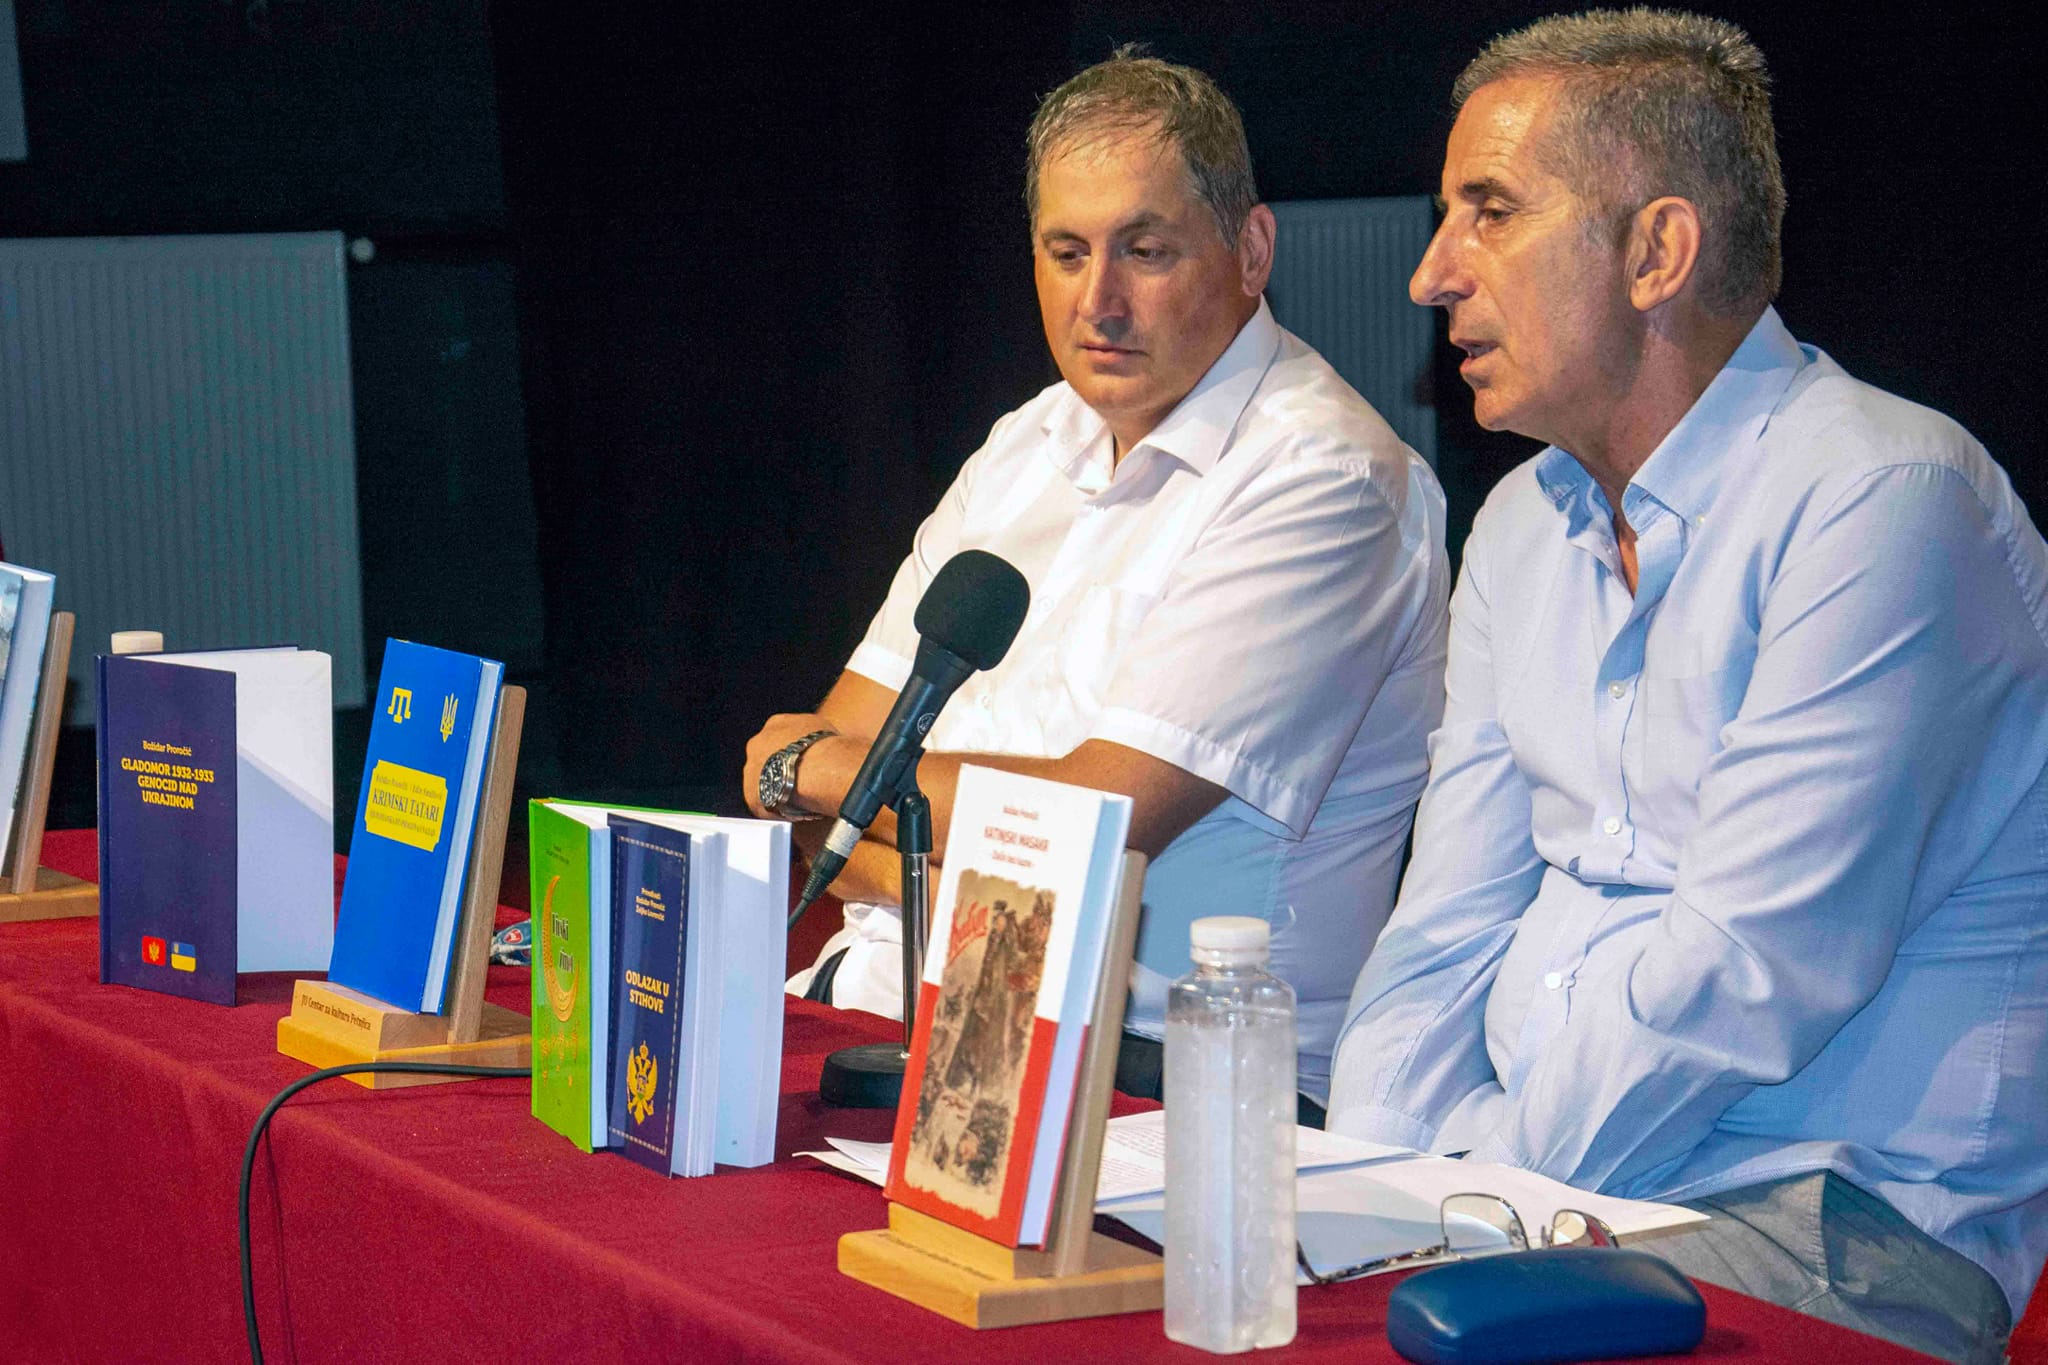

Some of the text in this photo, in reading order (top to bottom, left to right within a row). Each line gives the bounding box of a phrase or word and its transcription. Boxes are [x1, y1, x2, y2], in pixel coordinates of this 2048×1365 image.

[121, 757, 215, 783] GLADOMOR 1932-1933
[137, 775, 199, 795] GENOCID NAD
[142, 790, 195, 810] UKRAJINOM
[373, 788, 409, 813] KRIMSKI
[409, 799, 441, 822] TATARI
[625, 969, 670, 998] ODLAZAK U
[629, 988, 664, 1014] STIHOVE
